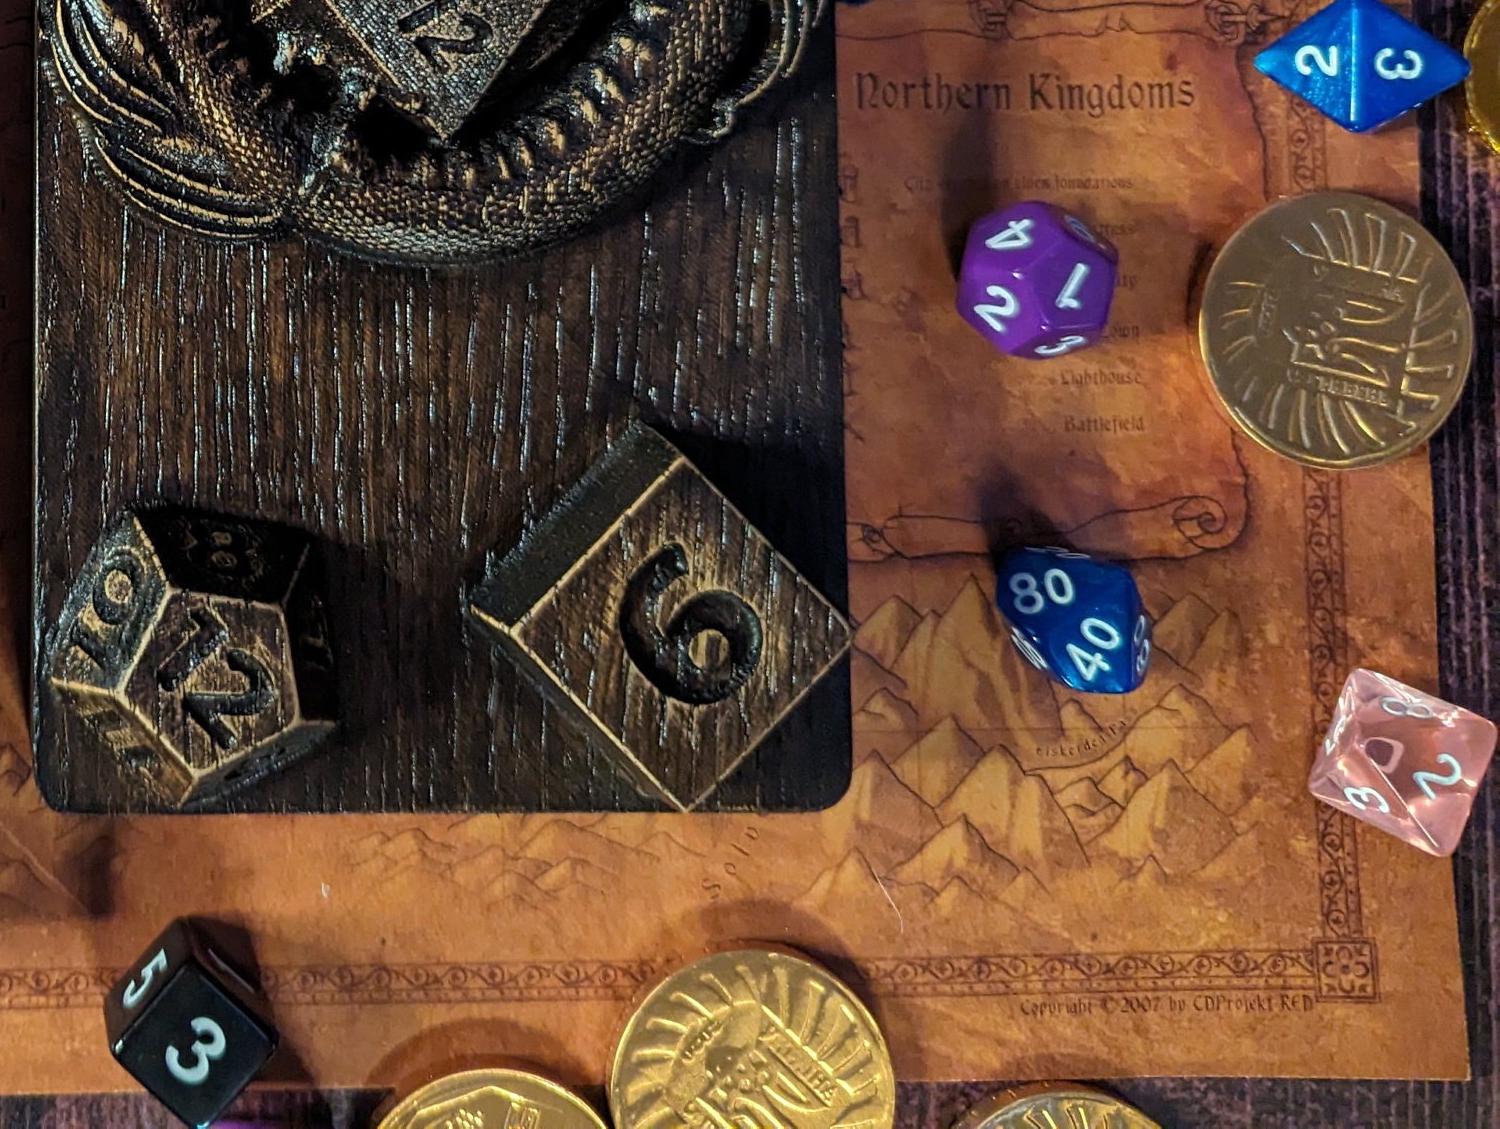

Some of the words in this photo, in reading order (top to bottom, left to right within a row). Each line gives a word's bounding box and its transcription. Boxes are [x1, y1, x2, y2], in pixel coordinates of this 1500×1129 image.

[1294, 44, 1339, 78] 2
[1374, 47, 1425, 81] 3
[855, 73, 1012, 114] Northern
[1029, 73, 1196, 118] Kingdoms
[984, 218, 1035, 250] 4
[973, 284, 1020, 334] 2
[1033, 334, 1088, 357] 3
[1063, 416, 1146, 433] Battlefield
[1008, 567, 1076, 615] 80
[618, 541, 765, 707] 6
[1065, 616, 1121, 682] 40
[156, 608, 280, 751] 12
[1412, 753, 1463, 800] 2
[1343, 786, 1391, 814] 3
[122, 947, 169, 1010] 5
[1019, 994, 1094, 1016] Copyright
[1279, 992, 1315, 1012] RED
[164, 1016, 227, 1085] 3
